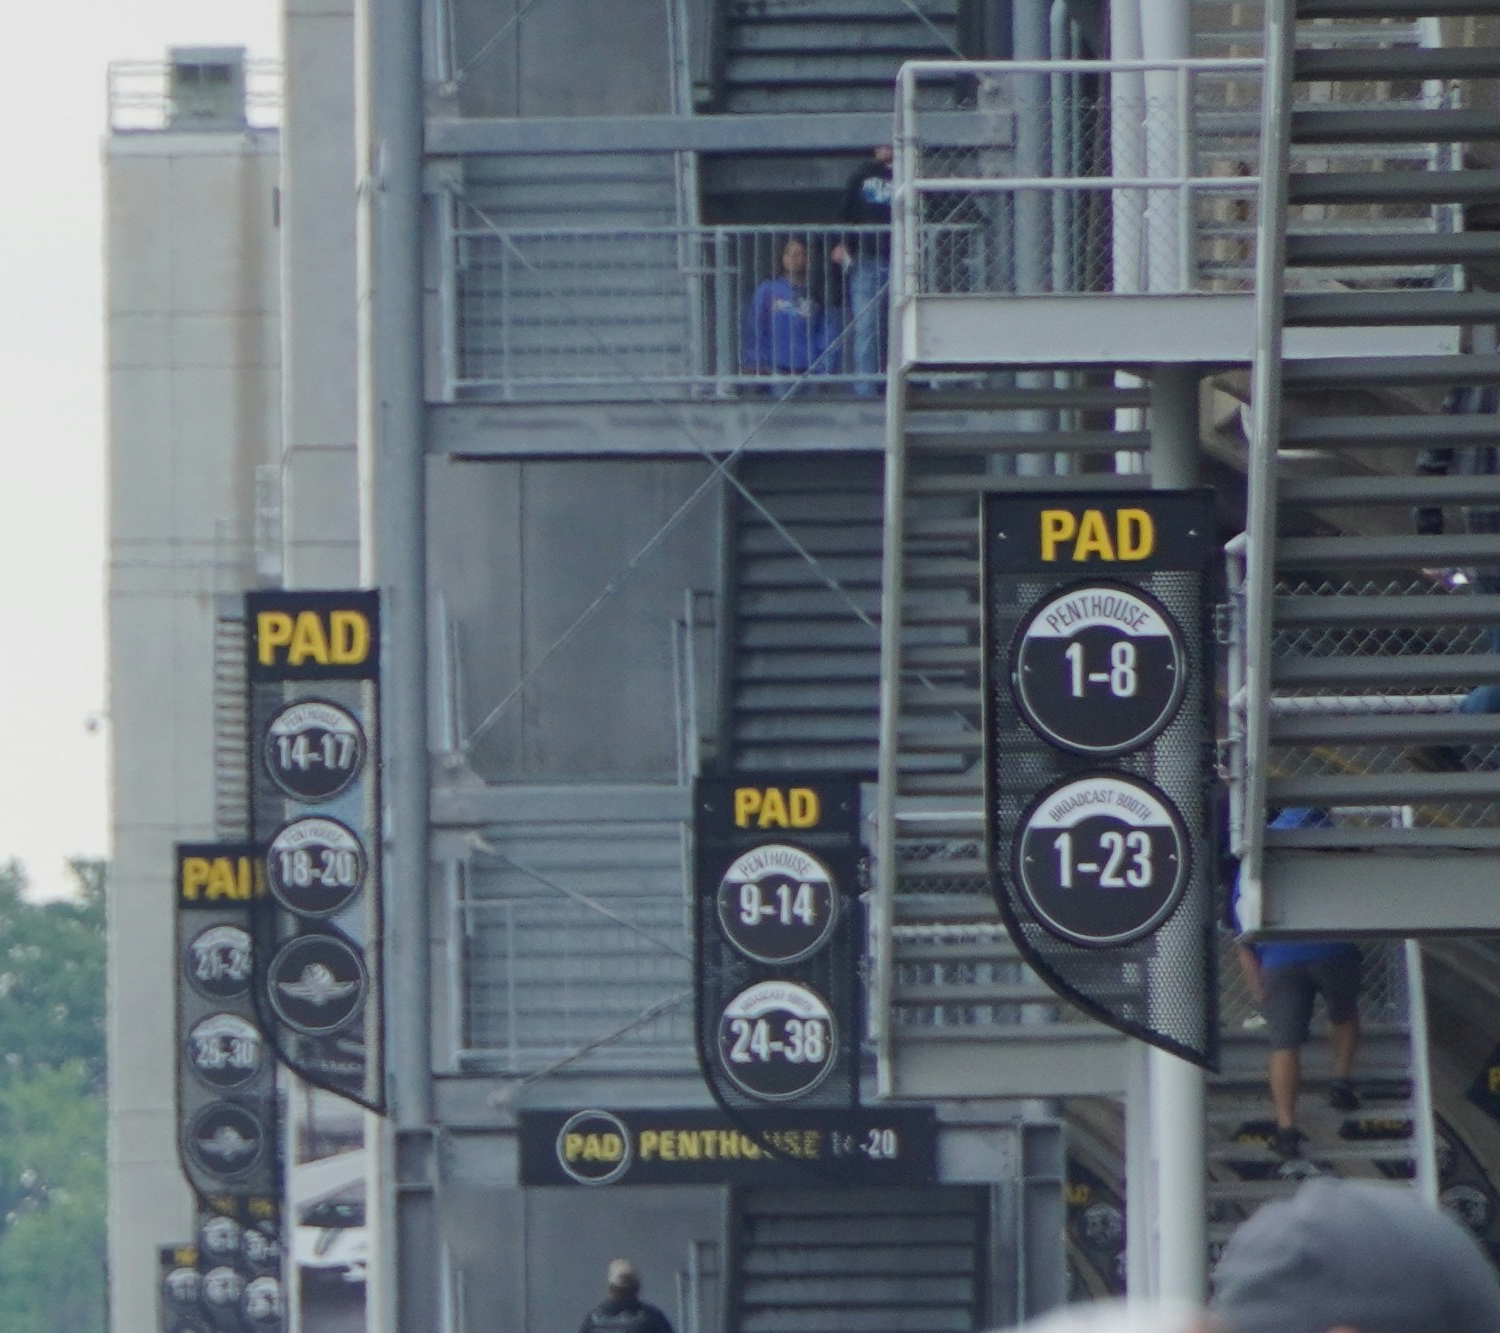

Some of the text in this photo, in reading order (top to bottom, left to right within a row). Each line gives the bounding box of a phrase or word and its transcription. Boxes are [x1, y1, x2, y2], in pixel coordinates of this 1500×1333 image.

[1040, 508, 1156, 561] PAD
[1046, 596, 1150, 633] PENTHOUSE
[257, 610, 370, 667] PAD
[1065, 641, 1137, 698] 1-8
[277, 733, 357, 771] 14-17
[734, 787, 820, 829] PAD
[1048, 790, 1153, 822] BROADCAST BOOTH
[279, 850, 355, 888] 18-20
[739, 850, 814, 878] PENTHOUSE
[1054, 831, 1153, 888] 1-23
[739, 884, 816, 926] 9-14
[730, 1019, 826, 1063] 24-38
[564, 1132, 623, 1163] PAD
